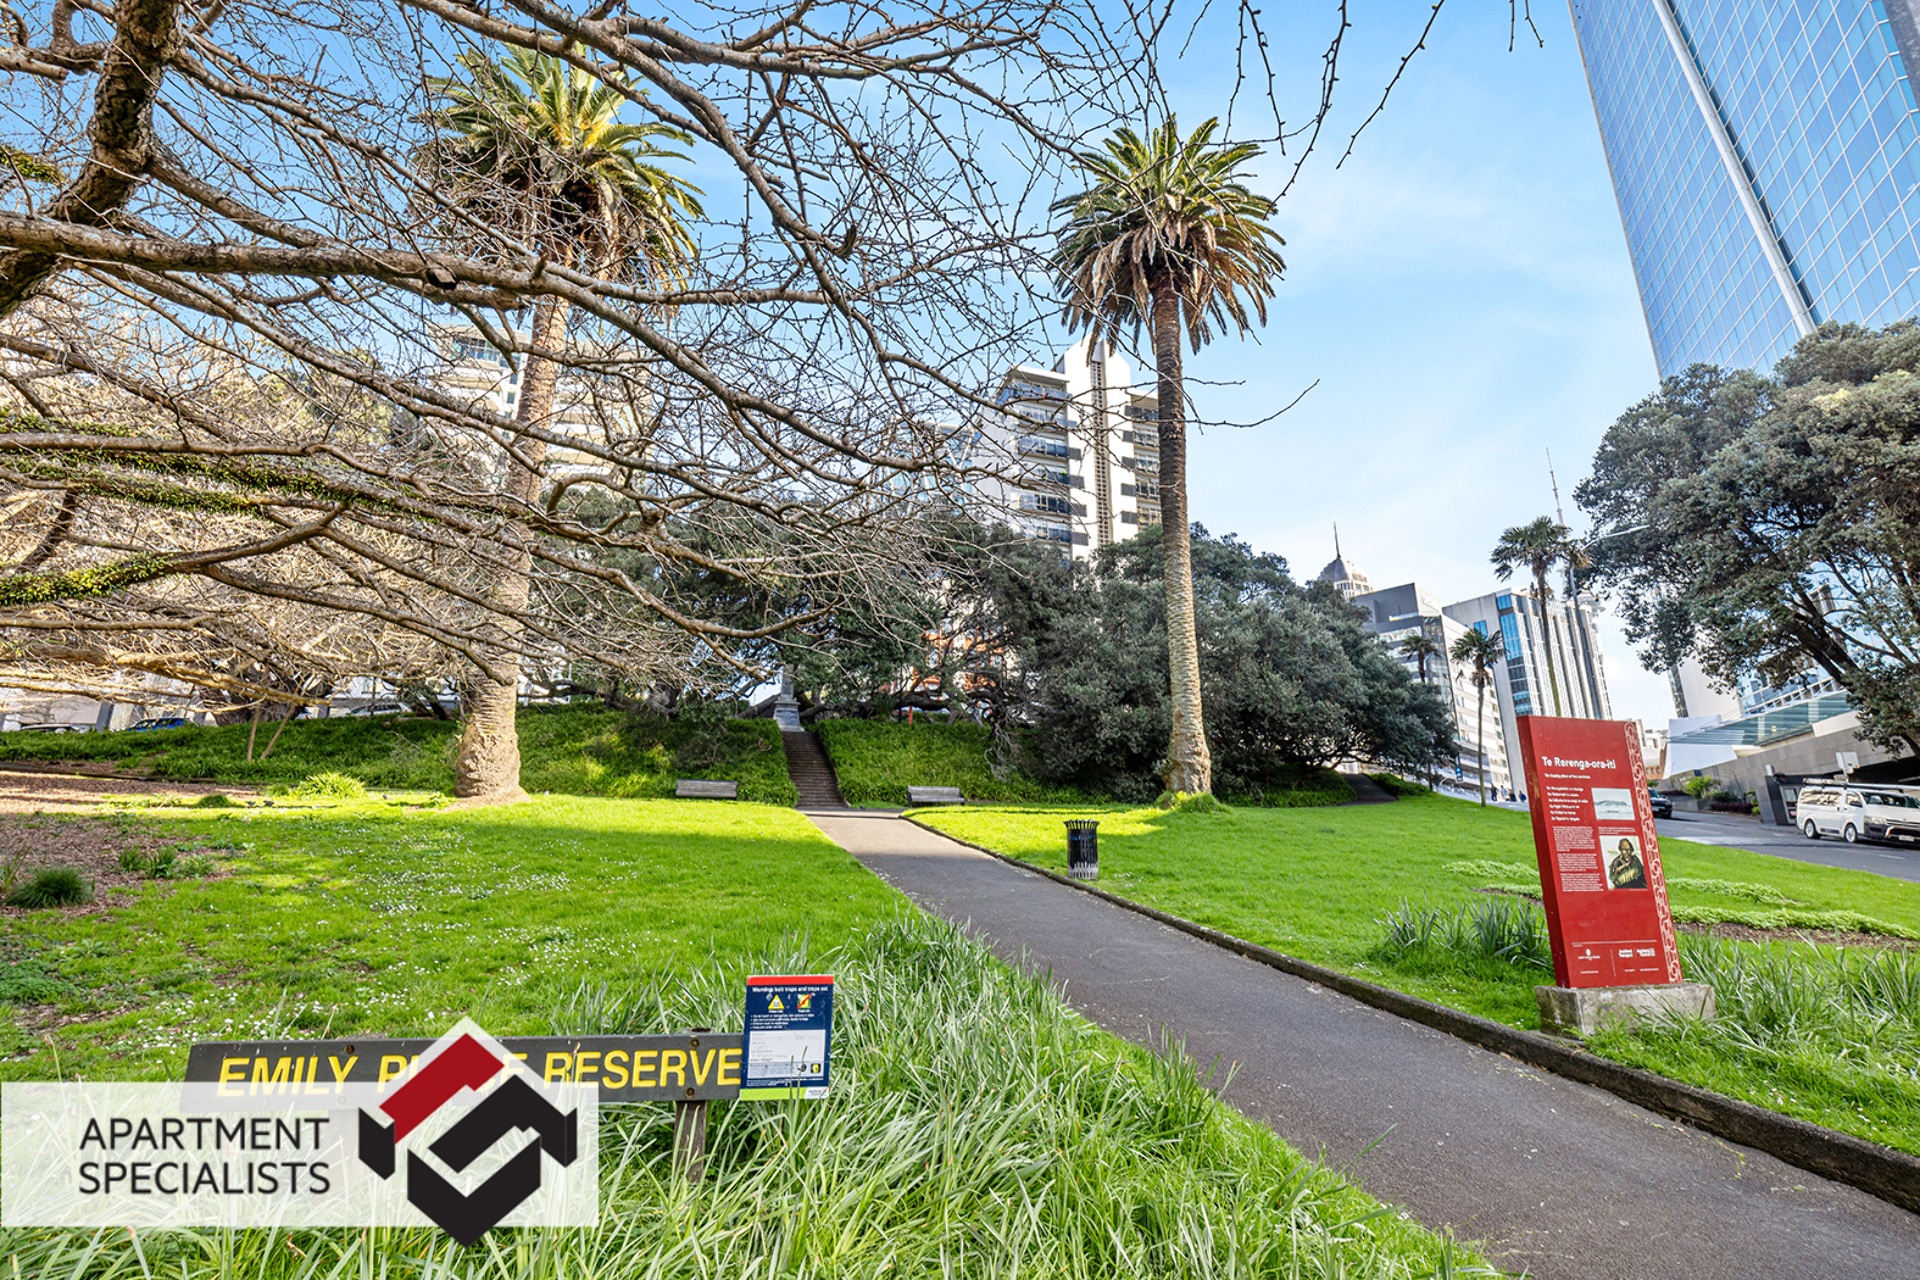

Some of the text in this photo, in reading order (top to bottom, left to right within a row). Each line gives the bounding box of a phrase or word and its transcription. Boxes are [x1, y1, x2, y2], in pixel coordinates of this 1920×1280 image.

[1541, 756, 1616, 771] Te Rerenga-ora-iti
[216, 1056, 358, 1097] EMILY
[543, 1048, 742, 1090] RESERVE
